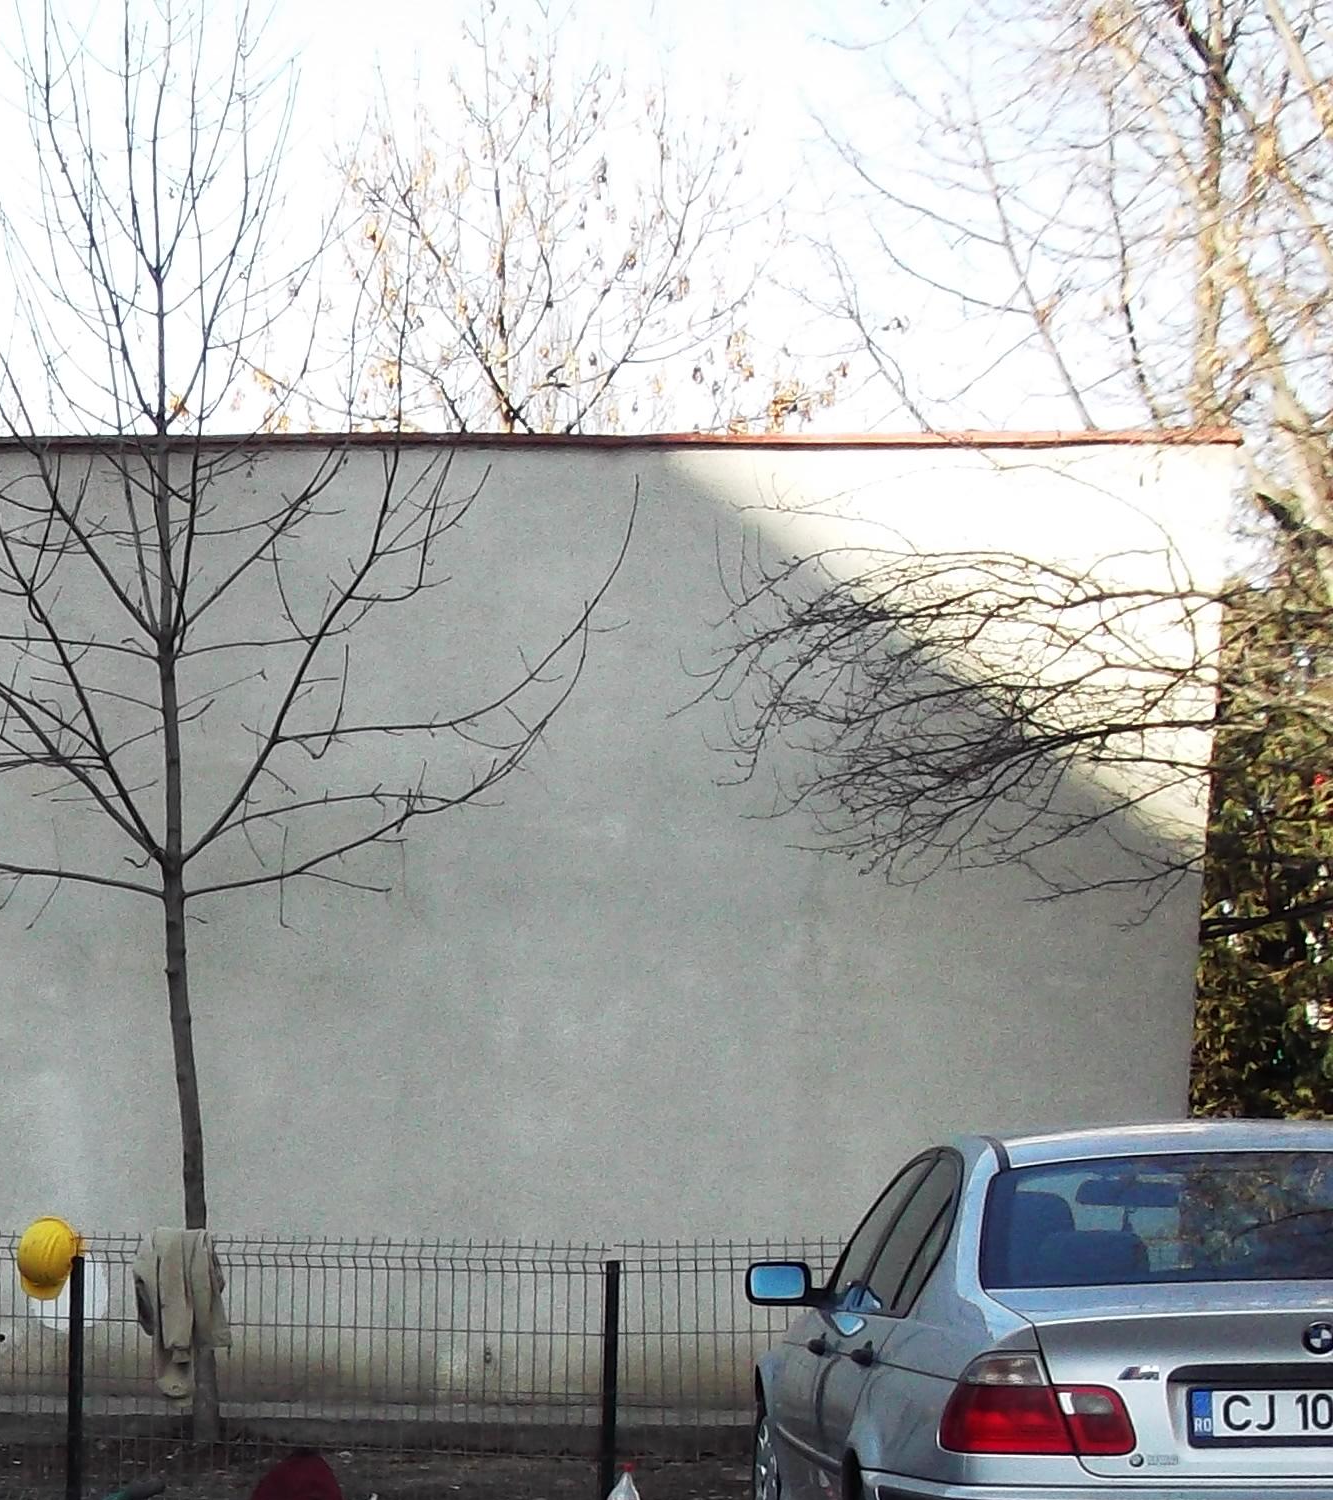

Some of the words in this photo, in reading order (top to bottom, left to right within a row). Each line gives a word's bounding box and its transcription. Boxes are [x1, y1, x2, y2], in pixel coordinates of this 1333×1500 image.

[1194, 1418, 1213, 1432] RO
[1223, 1394, 1275, 1431] CJ
[1295, 1393, 1333, 1430] 10
